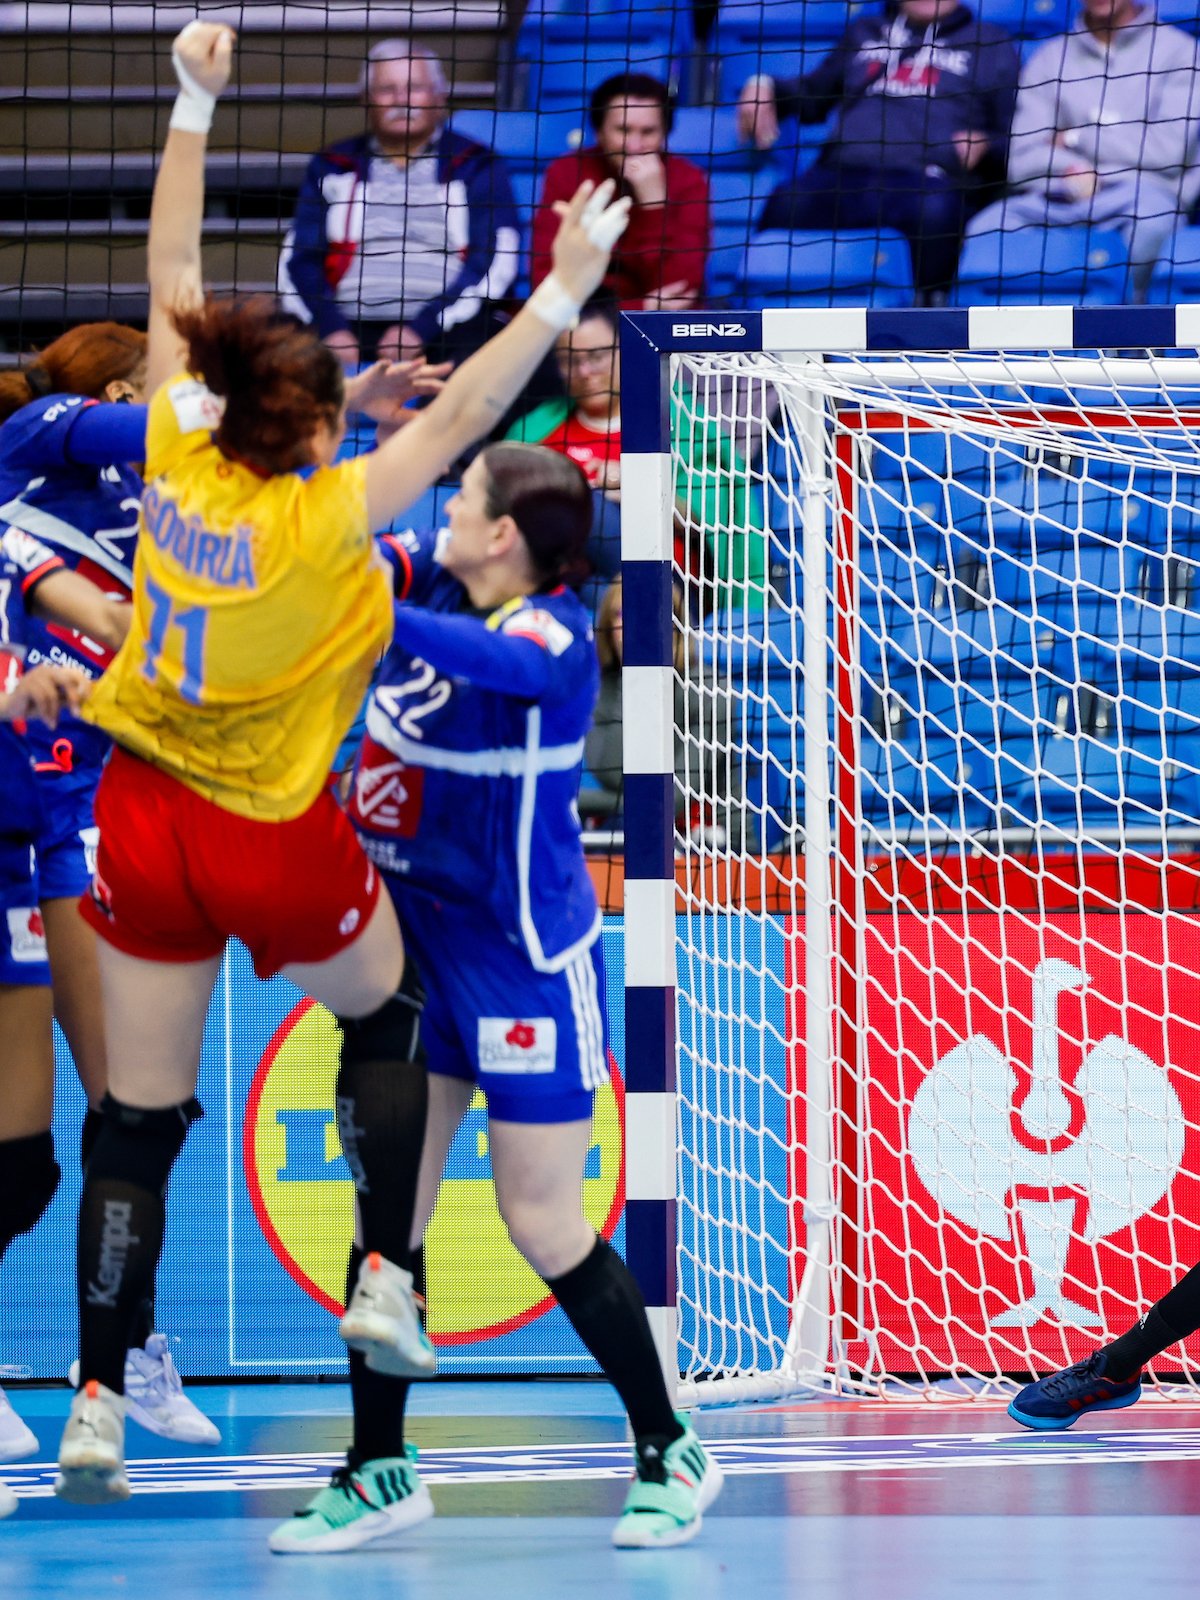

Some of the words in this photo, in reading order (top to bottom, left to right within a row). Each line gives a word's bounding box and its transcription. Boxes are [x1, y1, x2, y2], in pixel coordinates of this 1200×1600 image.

[672, 323, 742, 337] BENZ
[138, 577, 207, 706] 71
[376, 656, 451, 740] 22
[87, 1200, 140, 1307] Kempa
